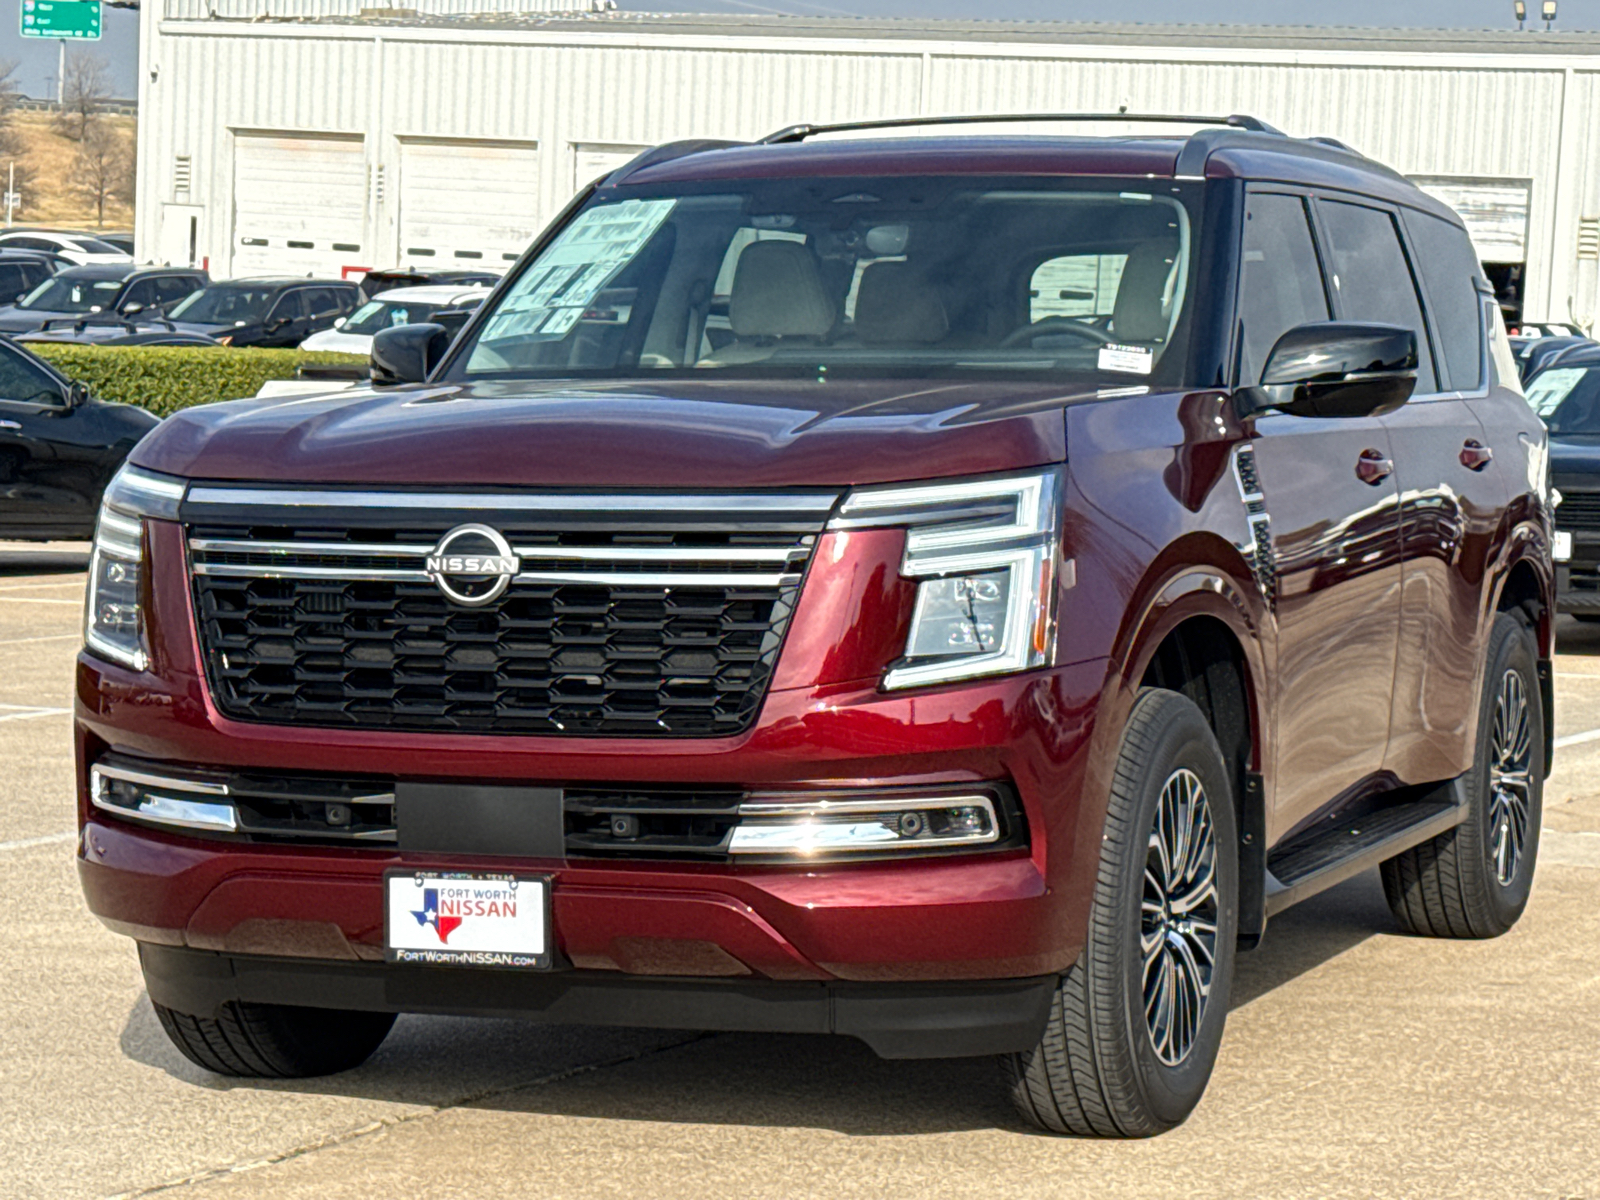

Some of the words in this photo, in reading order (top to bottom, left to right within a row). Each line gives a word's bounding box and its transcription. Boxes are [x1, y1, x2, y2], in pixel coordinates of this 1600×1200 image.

[427, 557, 515, 572] NISSAN
[441, 888, 470, 899] FORT
[474, 889, 516, 900] WORTH
[441, 899, 516, 917] NISSAN
